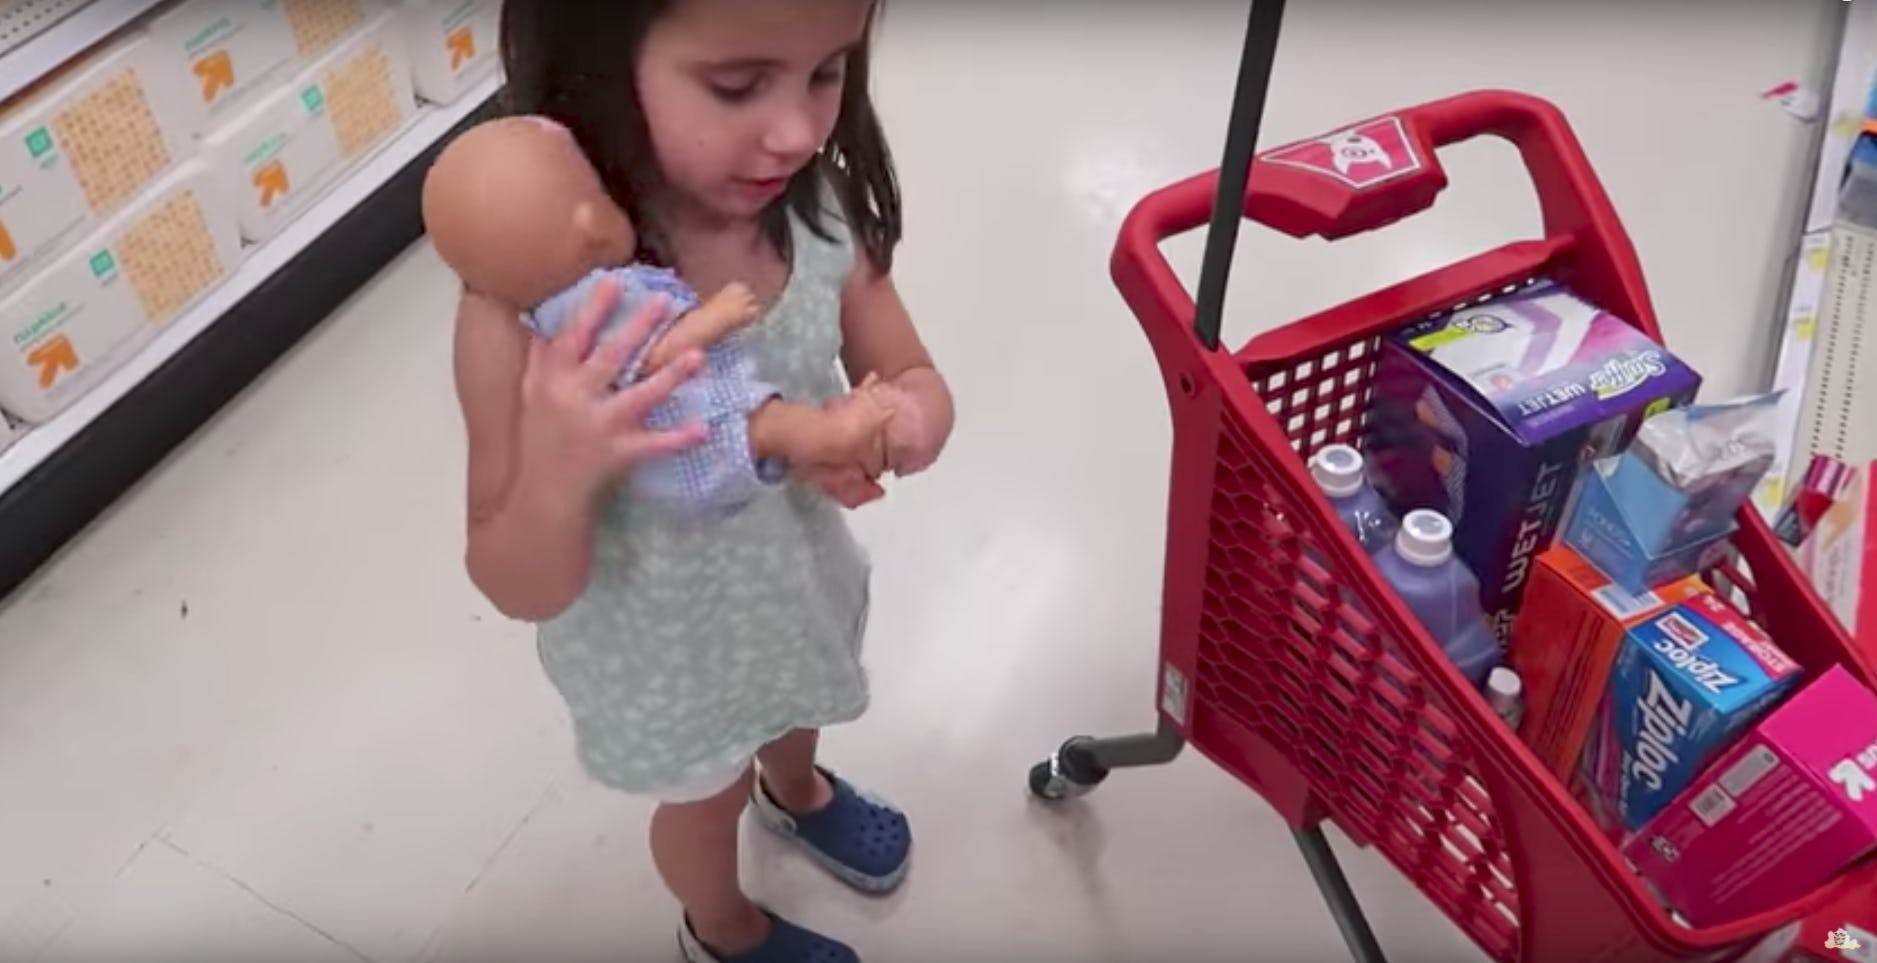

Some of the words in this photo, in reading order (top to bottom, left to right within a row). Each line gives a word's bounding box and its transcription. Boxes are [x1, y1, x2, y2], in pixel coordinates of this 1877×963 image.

[1589, 350, 1667, 397] Swiffer
[1501, 462, 1562, 593] WETJET
[1653, 637, 1739, 694] Ziploc
[1631, 668, 1693, 791] Ziploc
